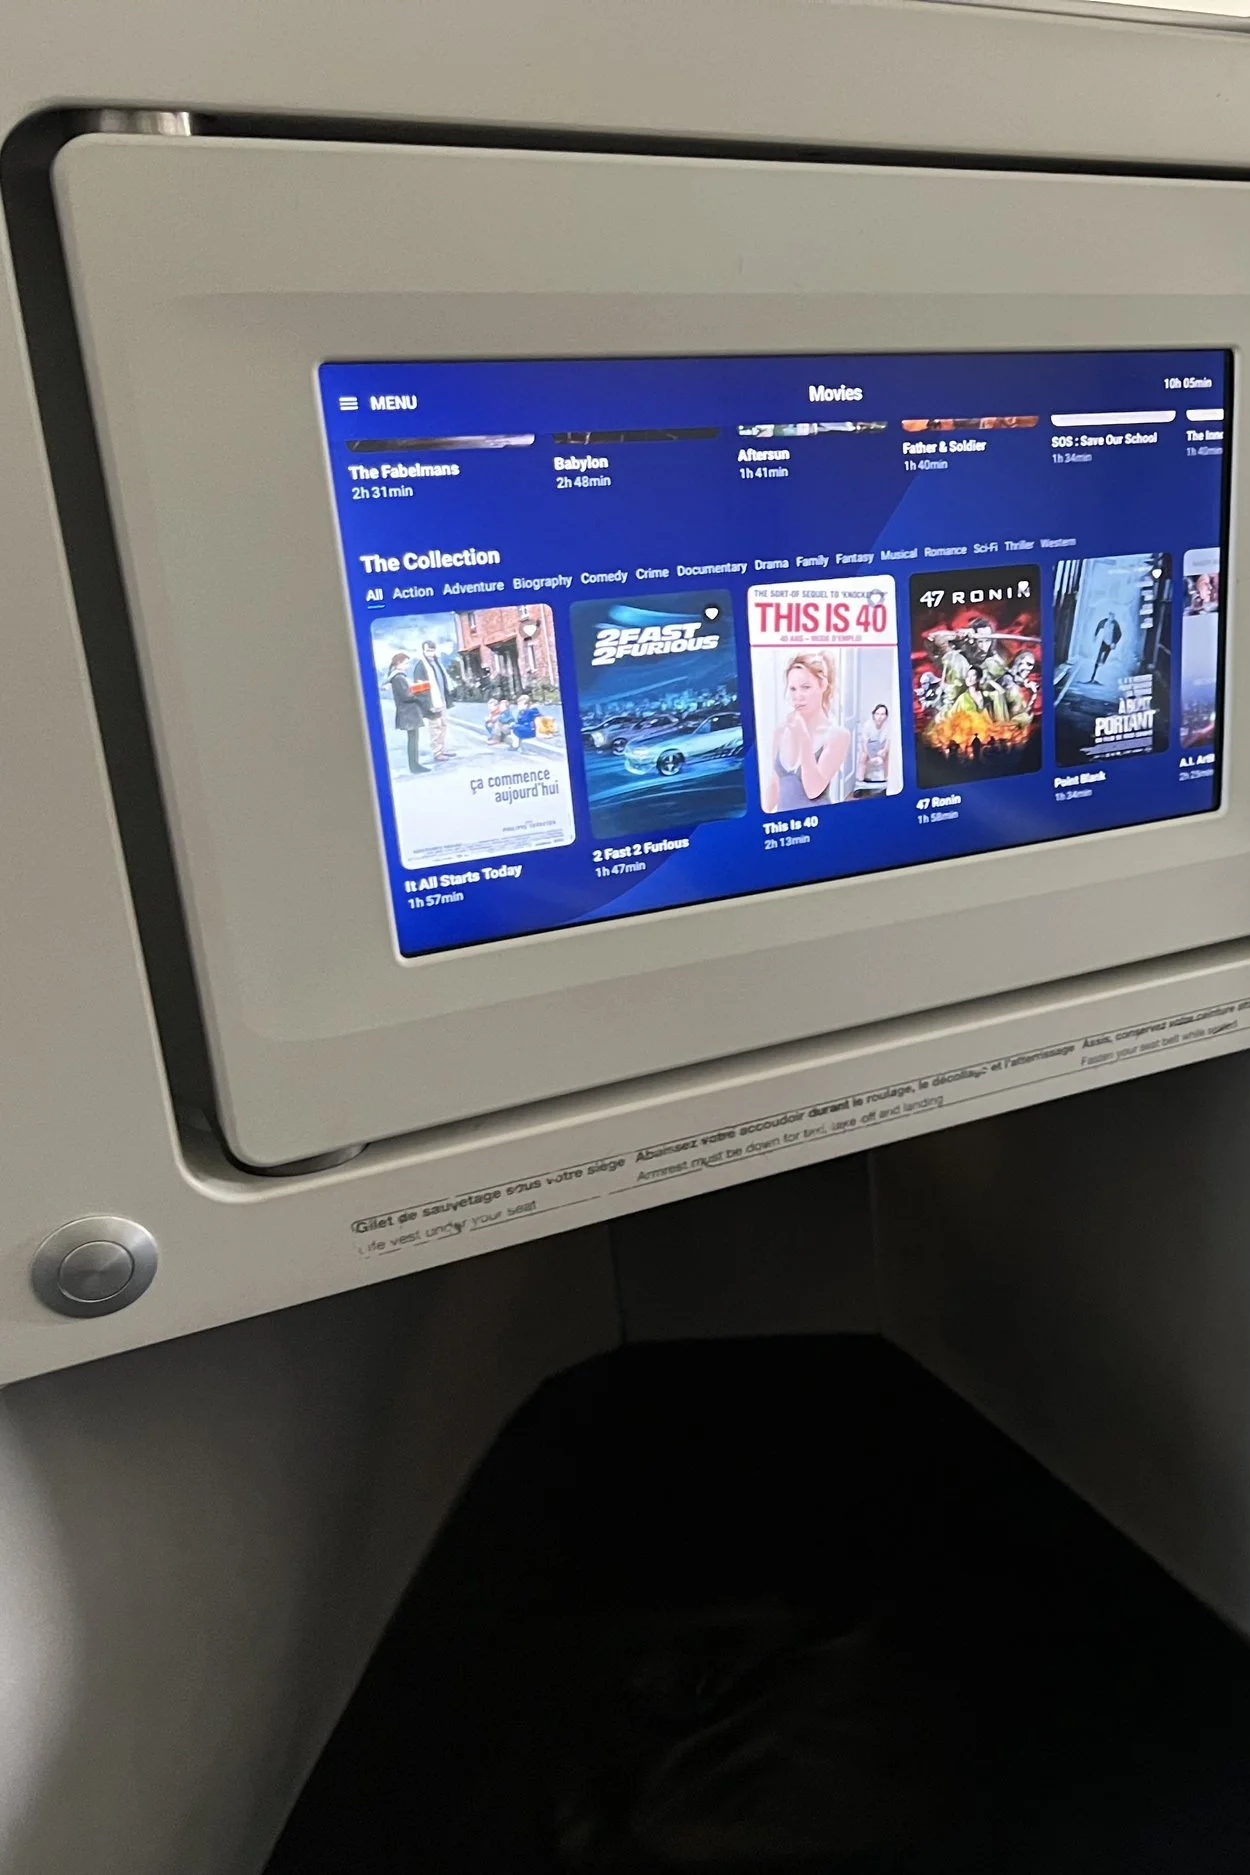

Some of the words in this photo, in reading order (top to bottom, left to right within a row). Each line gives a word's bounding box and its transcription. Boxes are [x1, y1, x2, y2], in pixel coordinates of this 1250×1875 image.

[809, 384, 863, 402] Movies
[370, 395, 418, 410] MENU
[1051, 436, 1073, 448] SOS
[1080, 435, 1105, 447] Save
[1105, 434, 1123, 445] Our
[1124, 432, 1157, 445] School
[1186, 430, 1204, 441] The
[737, 448, 790, 463] Aftersun
[903, 441, 937, 455] Father
[938, 441, 948, 453] &
[949, 439, 987, 453] Soldier
[554, 455, 608, 473] Babylon
[904, 460, 917, 471] 1h
[918, 459, 948, 471] 40min
[1053, 453, 1064, 463] 1h
[349, 465, 379, 481] The
[381, 462, 460, 479] Fabelmans
[740, 467, 754, 479] 1h
[755, 466, 789, 478] 41min
[557, 476, 572, 489] 2h
[574, 474, 611, 487] 48min
[353, 486, 370, 500] 2h
[372, 484, 413, 499] 31min
[360, 555, 400, 574] The
[403, 548, 501, 571] Collection
[366, 588, 384, 601] All
[393, 585, 434, 599] Action
[443, 579, 505, 597] Adventure
[513, 574, 573, 592] Biography
[581, 569, 628, 586] Comedy
[635, 566, 669, 581] Crime
[677, 561, 748, 577] Documentary
[754, 558, 789, 571] Drama
[796, 555, 829, 568] Family
[836, 552, 875, 565] Fantasy
[881, 547, 918, 561] Musical
[924, 544, 968, 558] Romance
[973, 542, 998, 554] Sci-Fi
[1004, 540, 1035, 552] Thriller
[754, 589, 768, 598] THE
[920, 590, 945, 608] 47
[754, 602, 820, 633] THIS
[826, 603, 850, 633] IS
[856, 603, 887, 633] 40
[1095, 710, 1156, 737] PORTANT
[470, 779, 484, 795] ça
[488, 769, 551, 788] commence
[1054, 775, 1079, 788] Point
[495, 780, 559, 805] aujourd'hui
[916, 797, 930, 810] 47
[932, 793, 962, 808] Ronin
[763, 821, 788, 835] This
[803, 816, 818, 828] 40
[918, 813, 929, 824] 1h
[593, 850, 602, 863] 2
[604, 846, 633, 861] Fast
[634, 844, 644, 857] 2
[645, 837, 690, 855] Furious
[764, 839, 778, 850] 2h
[780, 834, 810, 847] 13min
[405, 880, 416, 893] It
[419, 875, 438, 890] All
[440, 870, 480, 888] Starts
[482, 863, 523, 882] Today
[596, 865, 610, 878] 1h
[611, 860, 646, 875] 47min
[408, 897, 424, 910] 1h
[425, 891, 464, 908] 57min
[1115, 1021, 1167, 1041] conservez
[739, 1111, 805, 1136] accoudoir
[808, 1100, 850, 1118] durant
[852, 1096, 863, 1108] le
[866, 1083, 916, 1105] roulage,
[918, 1079, 929, 1091] le
[990, 1061, 1003, 1072] et
[726, 1147, 743, 1159] be
[783, 1131, 800, 1143] for
[879, 1105, 901, 1119] and
[903, 1094, 944, 1114] landing
[355, 1215, 394, 1234] Gilet
[397, 1211, 418, 1225] de
[422, 1188, 502, 1218] sauvetage
[506, 1178, 542, 1196] sous
[546, 1168, 583, 1186] votre
[390, 1229, 421, 1247] vest
[471, 1210, 502, 1227] your
[507, 1200, 537, 1217] seat
